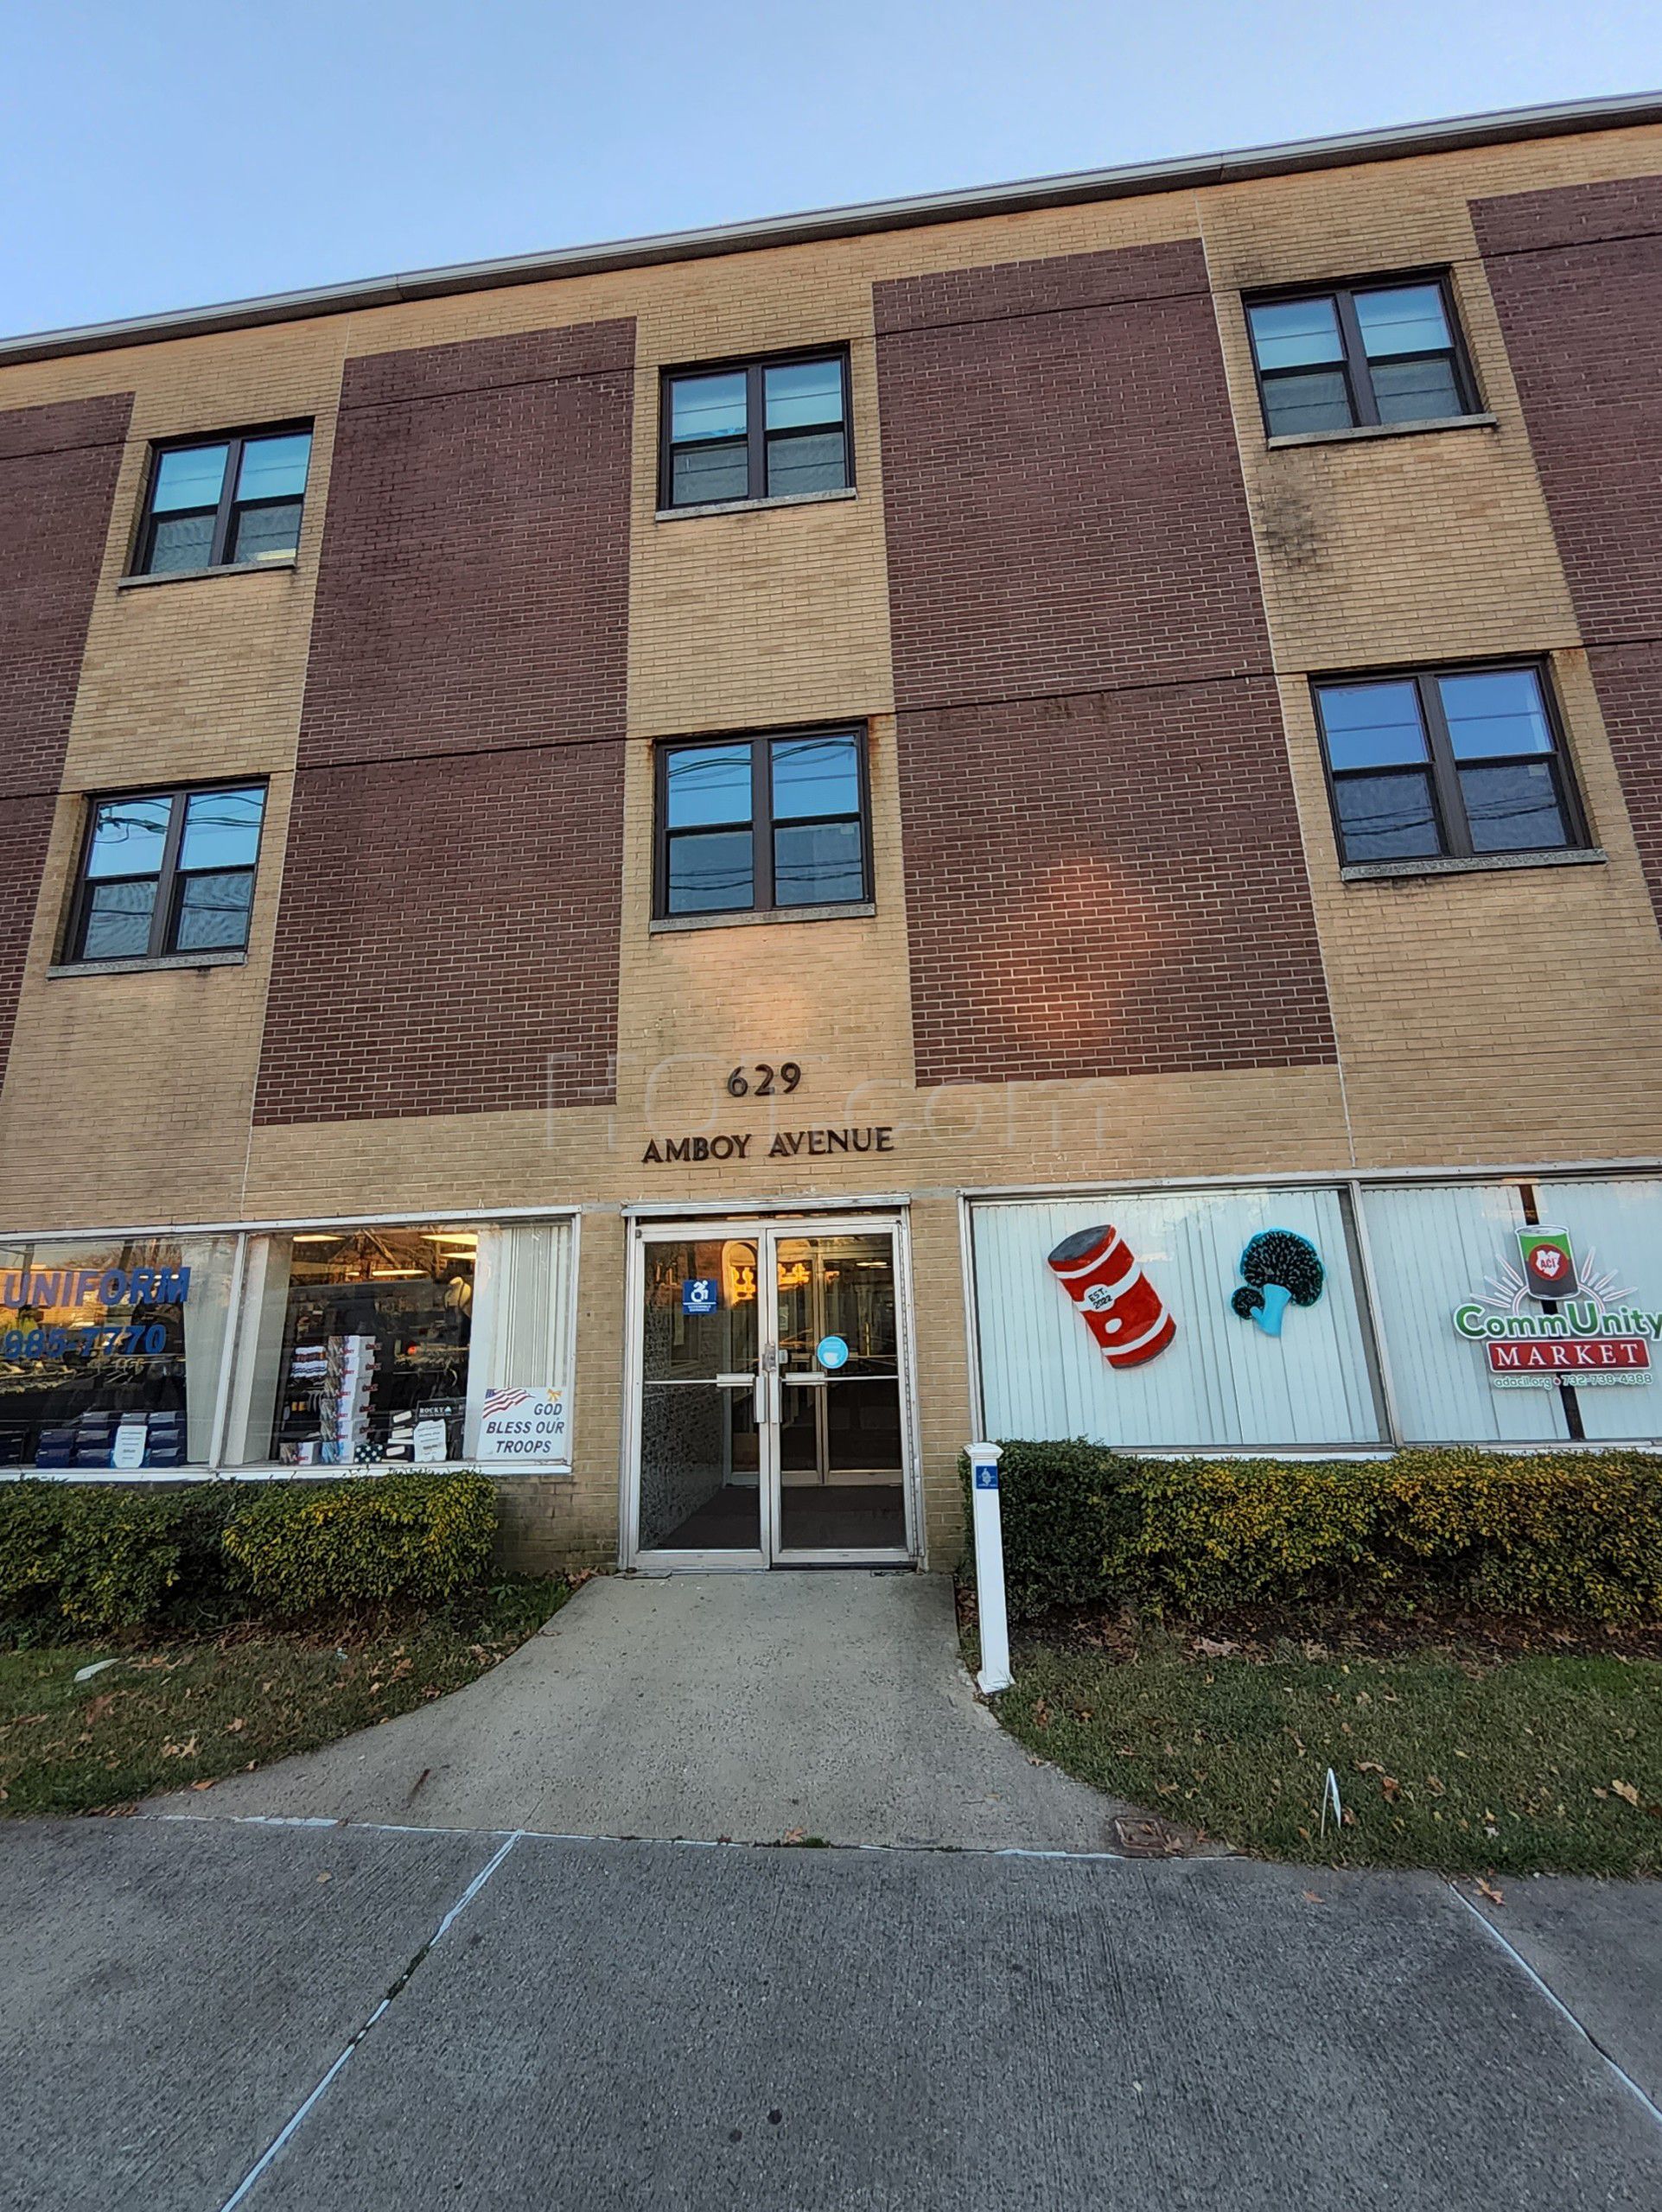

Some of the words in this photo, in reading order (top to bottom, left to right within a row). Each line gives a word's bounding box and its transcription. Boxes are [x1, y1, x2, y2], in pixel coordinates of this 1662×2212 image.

[727, 1062, 801, 1097] 629
[641, 1134, 751, 1163] AMBOY
[768, 1127, 895, 1158] AVENUE
[3, 1266, 191, 1309] UNIFORM
[1088, 1287, 1108, 1302] EST.
[1092, 1294, 1113, 1310] 2022
[1454, 1302, 1662, 1340] CommUnity
[1495, 1343, 1639, 1367] MARKET
[533, 1403, 563, 1416] GOD
[486, 1421, 532, 1434] BLESS
[535, 1421, 565, 1434] OUR
[496, 1440, 552, 1453] TROOPS
